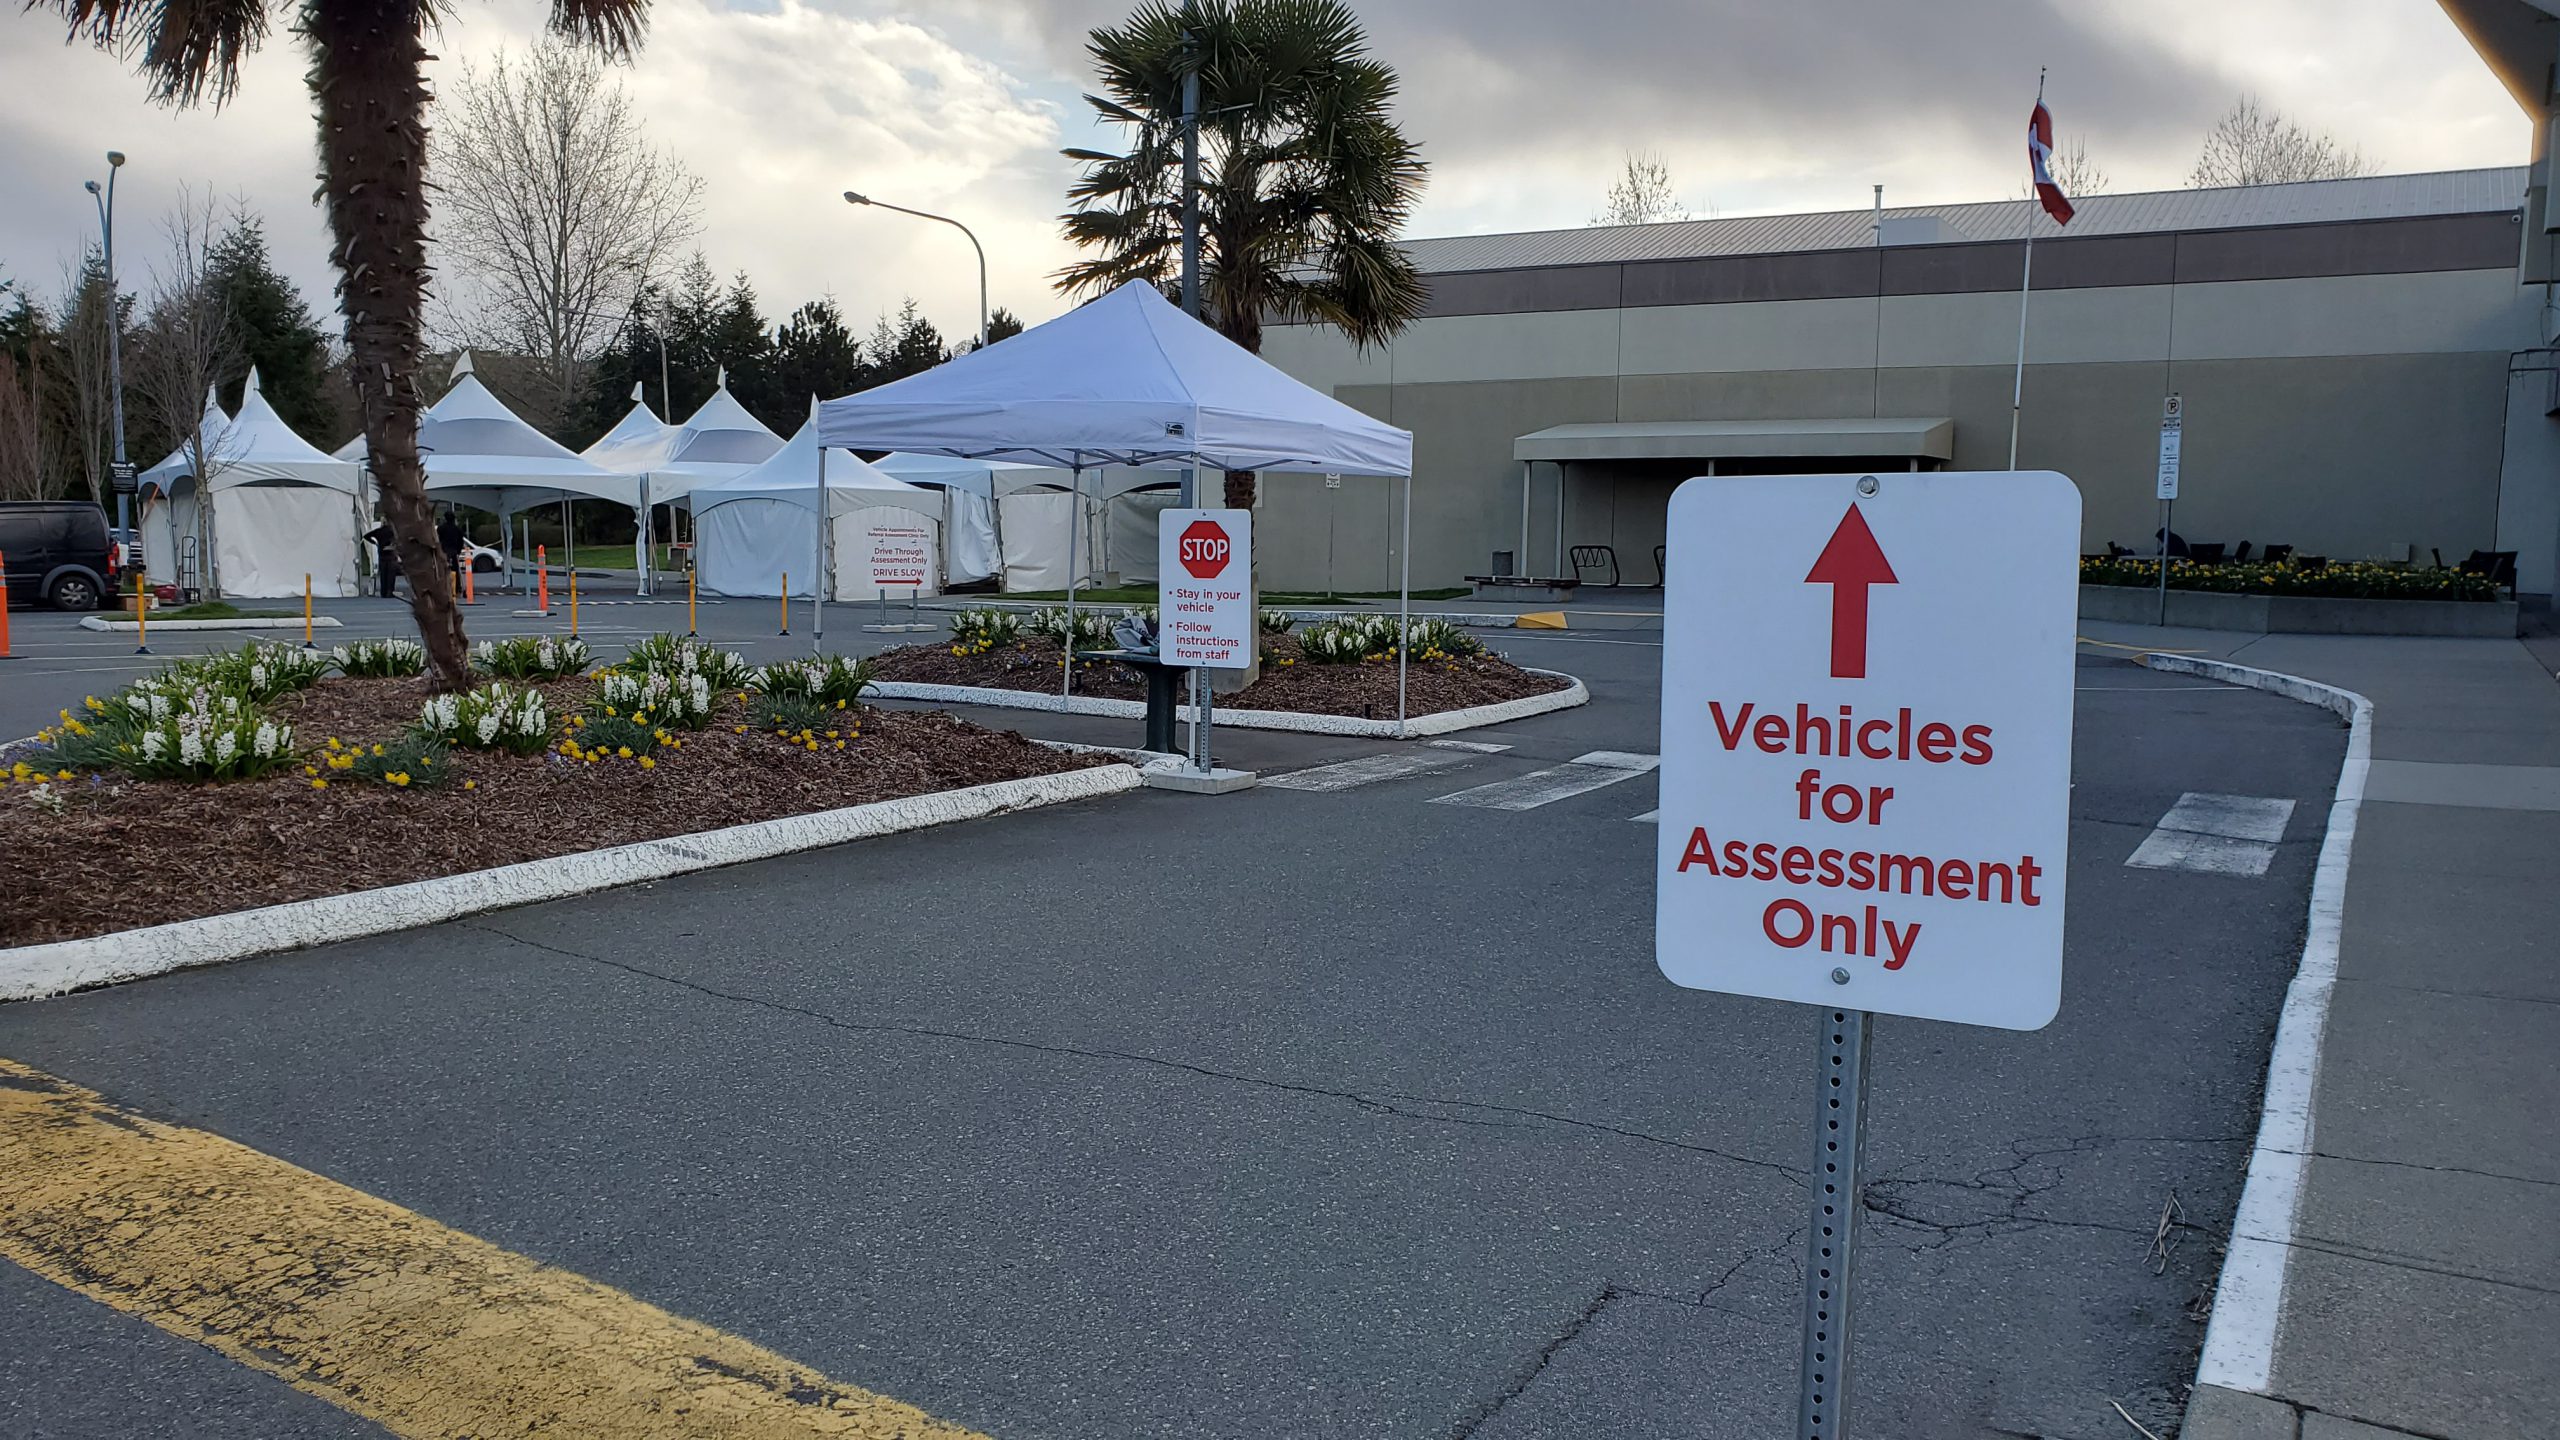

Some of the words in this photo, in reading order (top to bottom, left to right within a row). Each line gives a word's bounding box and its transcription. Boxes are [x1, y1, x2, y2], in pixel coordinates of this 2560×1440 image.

[874, 547, 893, 555] Drive
[894, 548, 924, 557] Through
[1183, 538, 1229, 561] STOP
[871, 556, 910, 564] Assessment
[911, 556, 928, 565] Only
[873, 568, 899, 577] DRIVE
[900, 568, 926, 577] SLOW
[1176, 588, 1200, 600] Stay
[1203, 588, 1213, 599] in
[1216, 591, 1241, 601] your
[1176, 602, 1215, 612] vehicle
[1176, 621, 1212, 632] Follow
[1176, 635, 1239, 647] instructions
[1176, 648, 1202, 659] from
[1205, 649, 1230, 660] staff
[1707, 701, 1994, 765] Vehicles
[1795, 769, 1894, 826] for
[1676, 826, 2043, 907] Assessment
[1762, 898, 1922, 971] Only
